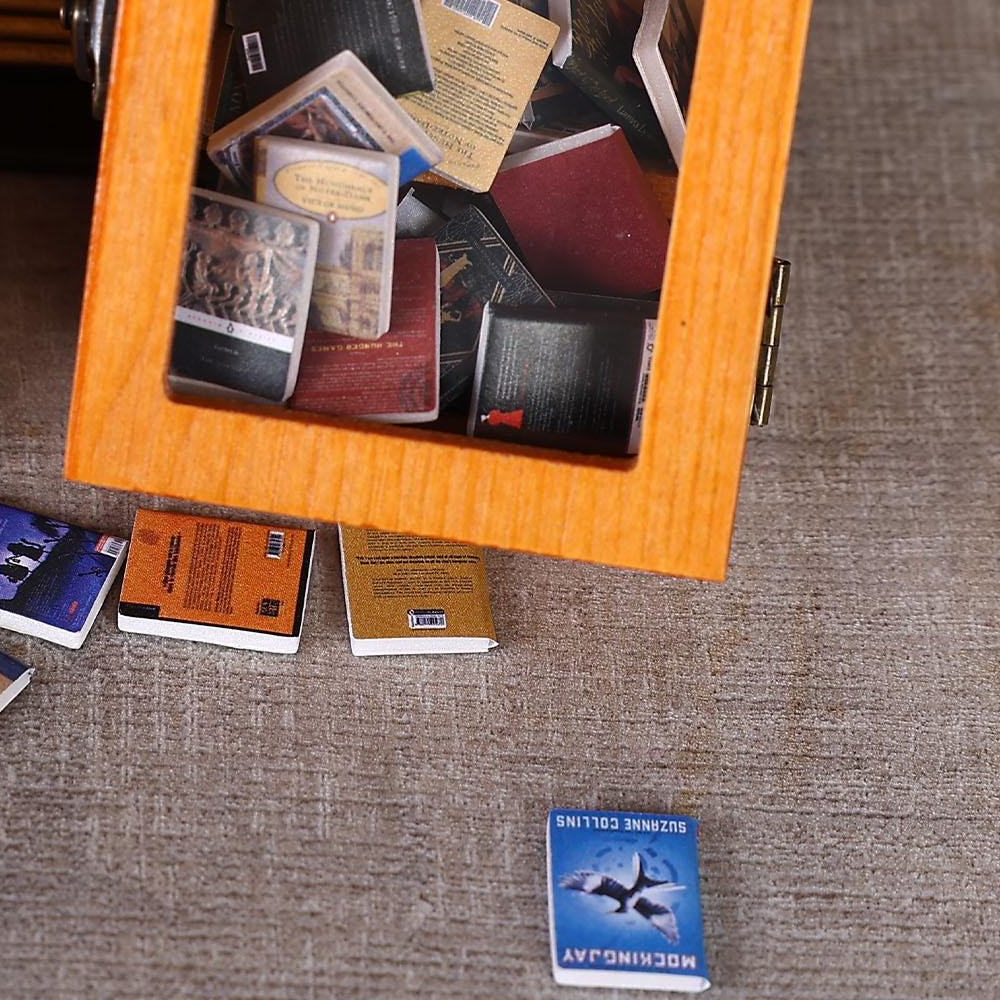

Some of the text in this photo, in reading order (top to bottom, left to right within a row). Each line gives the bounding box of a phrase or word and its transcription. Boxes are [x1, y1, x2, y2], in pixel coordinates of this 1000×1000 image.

[556, 815, 687, 834] SUZANNE COLLINS
[563, 948, 696, 969] MOCKINGJAY
